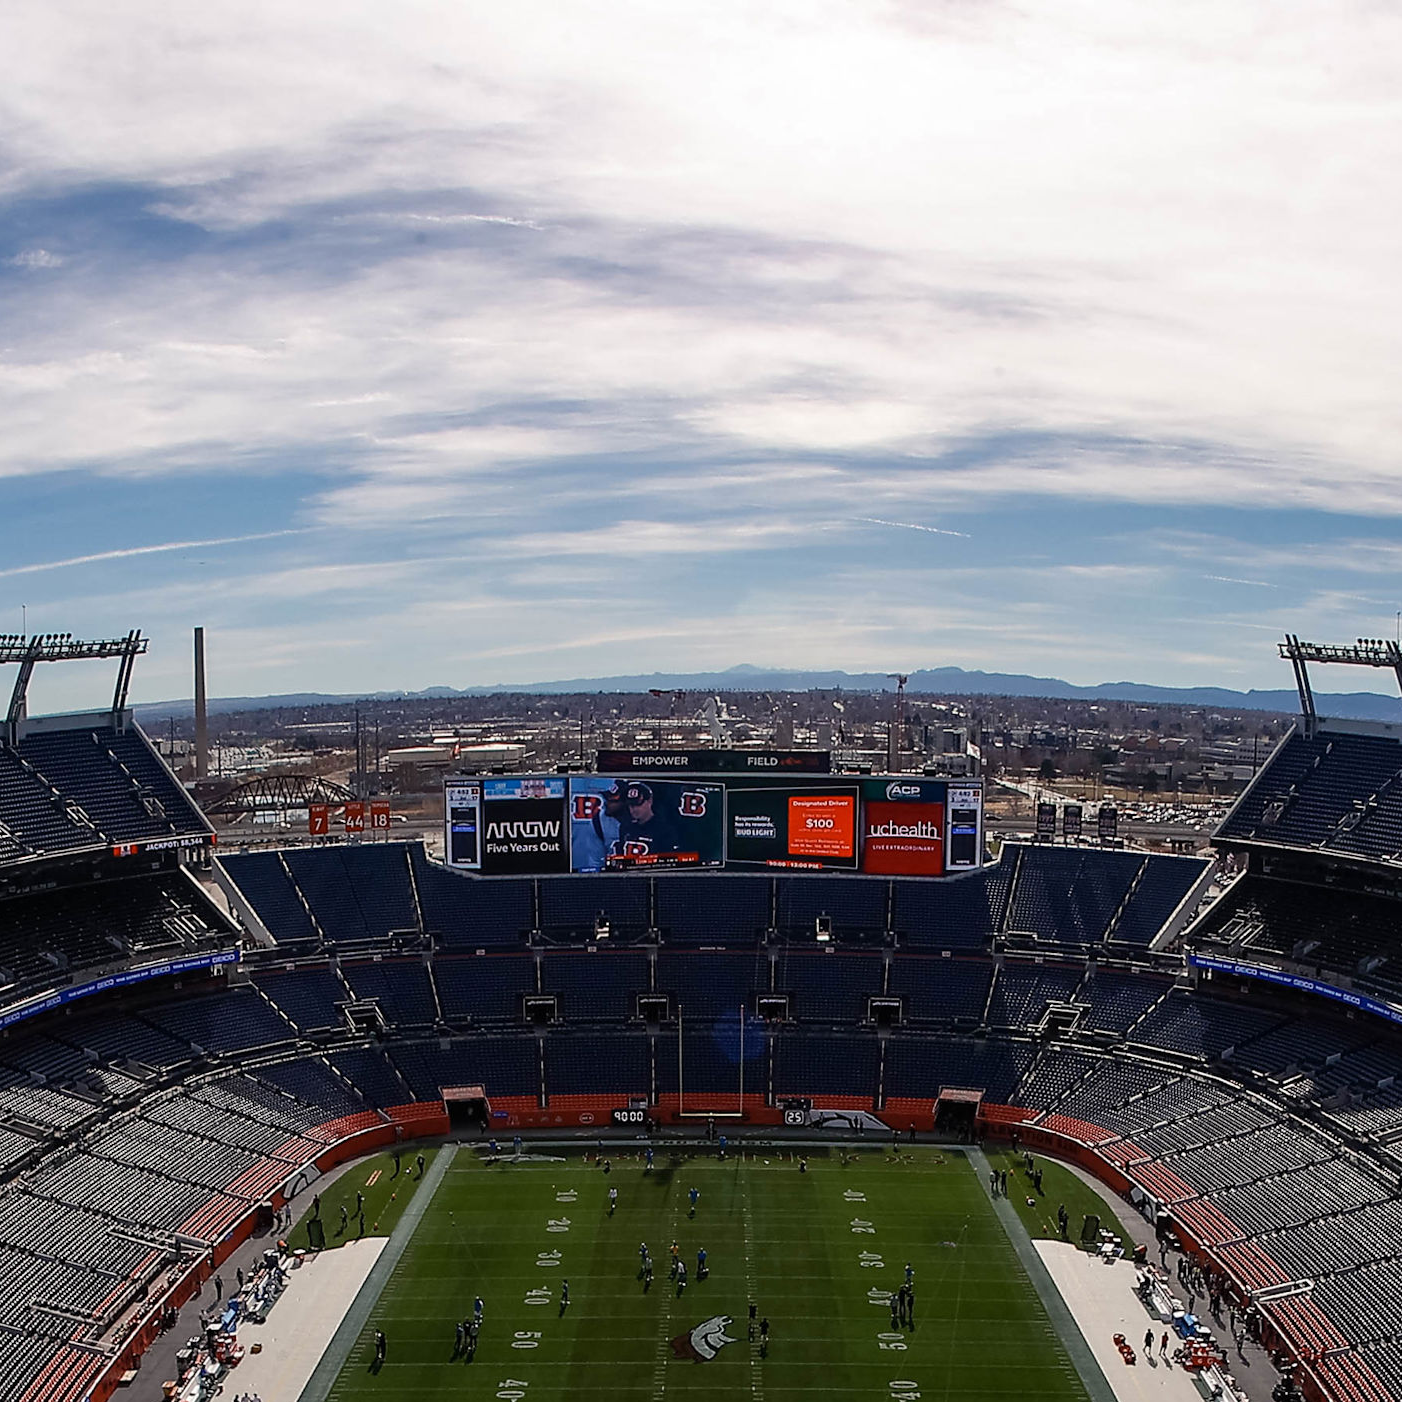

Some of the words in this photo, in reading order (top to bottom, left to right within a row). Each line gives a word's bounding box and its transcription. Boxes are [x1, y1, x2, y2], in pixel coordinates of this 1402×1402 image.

[632, 756, 689, 766] EMPOWER
[747, 757, 779, 766] FIELD
[891, 786, 921, 795] ACP
[486, 820, 560, 839] ARROW
[806, 819, 834, 829] $100
[870, 820, 938, 838] uchealth
[752, 829, 773, 837] LIGHT
[487, 843, 508, 853] Five
[510, 842, 538, 852] Years
[540, 841, 560, 852] Out
[211, 954, 236, 964] GEICO
[150, 965, 171, 976] GEICO
[1234, 965, 1258, 976] GEICO
[96, 978, 115, 990] GEICO
[1293, 978, 1315, 990] GEICO
[1342, 992, 1361, 1006] GEICO
[787, 1112, 802, 1122] 25
[556, 1190, 577, 1202] 10
[844, 1191, 867, 1203] 10
[546, 1219, 571, 1232] 20
[850, 1219, 876, 1234] 20
[536, 1251, 562, 1266] 30
[858, 1252, 885, 1268] 30
[524, 1289, 552, 1305] 40
[511, 1331, 542, 1349] 50
[877, 1332, 908, 1351] 50
[496, 1379, 528, 1399] 40
[888, 1380, 921, 1400] 40
